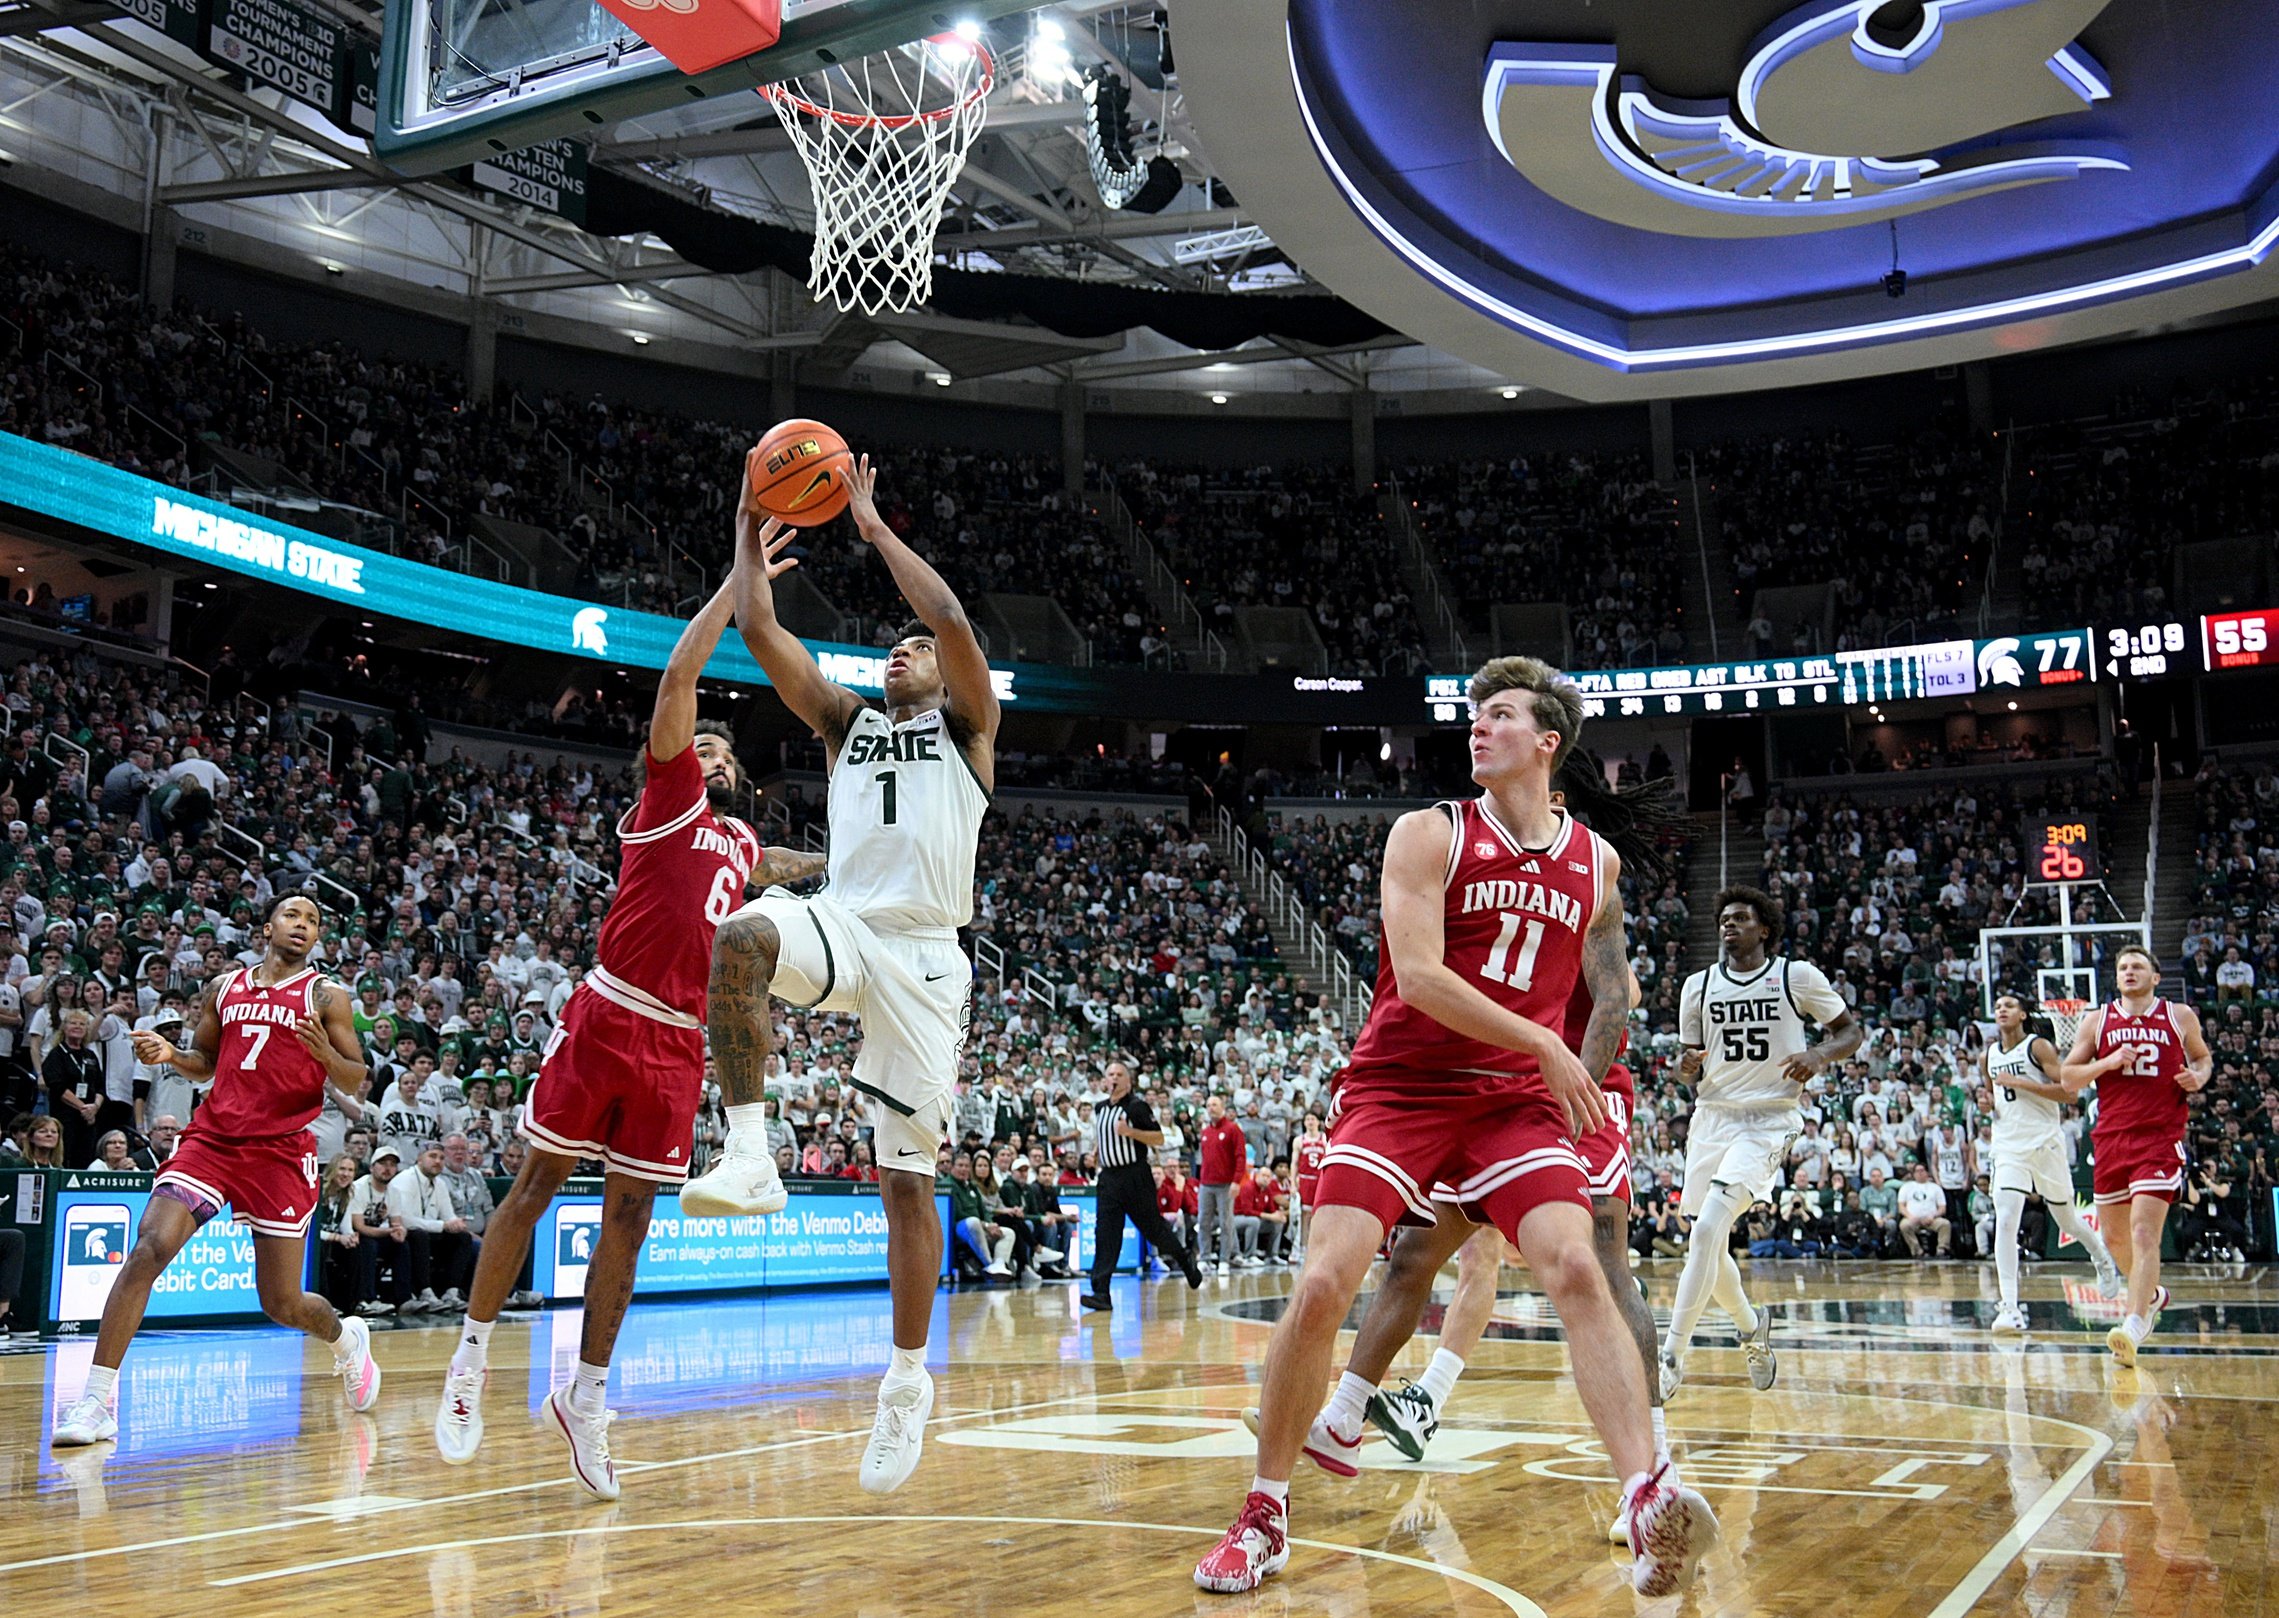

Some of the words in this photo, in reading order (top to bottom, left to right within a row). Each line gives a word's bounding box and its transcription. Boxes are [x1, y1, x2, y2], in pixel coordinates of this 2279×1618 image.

[229, 0, 334, 60] TOURNAMENT
[226, 14, 334, 80] CHAMPIONS
[245, 48, 308, 95] 2005
[532, 147, 565, 172] TEN
[508, 176, 552, 206] 2014
[184, 227, 206, 244] 212
[152, 496, 286, 571] MICHIGAN
[288, 541, 366, 594] STATE
[2108, 623, 2185, 657] 3:09
[2214, 617, 2268, 654] 55
[1927, 652, 1952, 664] FLS
[1957, 650, 1964, 661] 7
[2034, 636, 2082, 672] 77
[2130, 655, 2167, 676] 2ND
[2220, 652, 2259, 667] BONUS
[1695, 667, 1728, 686] AST
[1773, 662, 1796, 680] TO
[1802, 659, 1836, 678] STL
[1928, 675, 1953, 687] TOL
[1957, 673, 1966, 684] 3
[847, 727, 942, 766] STATE
[875, 771, 897, 825] 1
[2047, 824, 2086, 845] 3:09
[2042, 846, 2084, 878] 26
[704, 866, 737, 926] 6
[1462, 880, 1582, 934] INDIANA
[1480, 912, 1546, 992] 11
[222, 1003, 299, 1031] INDIANA
[1709, 998, 1781, 1024] STATE
[240, 1024, 271, 1070] 7
[1722, 1027, 1769, 1062] 55
[2106, 1027, 2171, 1048] INDIANA
[648, 1217, 679, 1239] ore
[683, 1217, 727, 1237] more
[731, 1214, 766, 1236] with
[770, 1211, 798, 1236] the
[802, 1211, 850, 1236] Venmo
[192, 1243, 226, 1265] the
[649, 1243, 677, 1262] Earn
[679, 1242, 734, 1265] always-on
[736, 1242, 760, 1259] cash
[762, 1241, 786, 1258] back
[790, 1241, 812, 1257] with
[813, 1240, 846, 1257] Venmo
[847, 1238, 875, 1256] Stash
[153, 1270, 196, 1293] ebit
[201, 1266, 256, 1291] Card.
[57, 1322, 80, 1332] ANC
